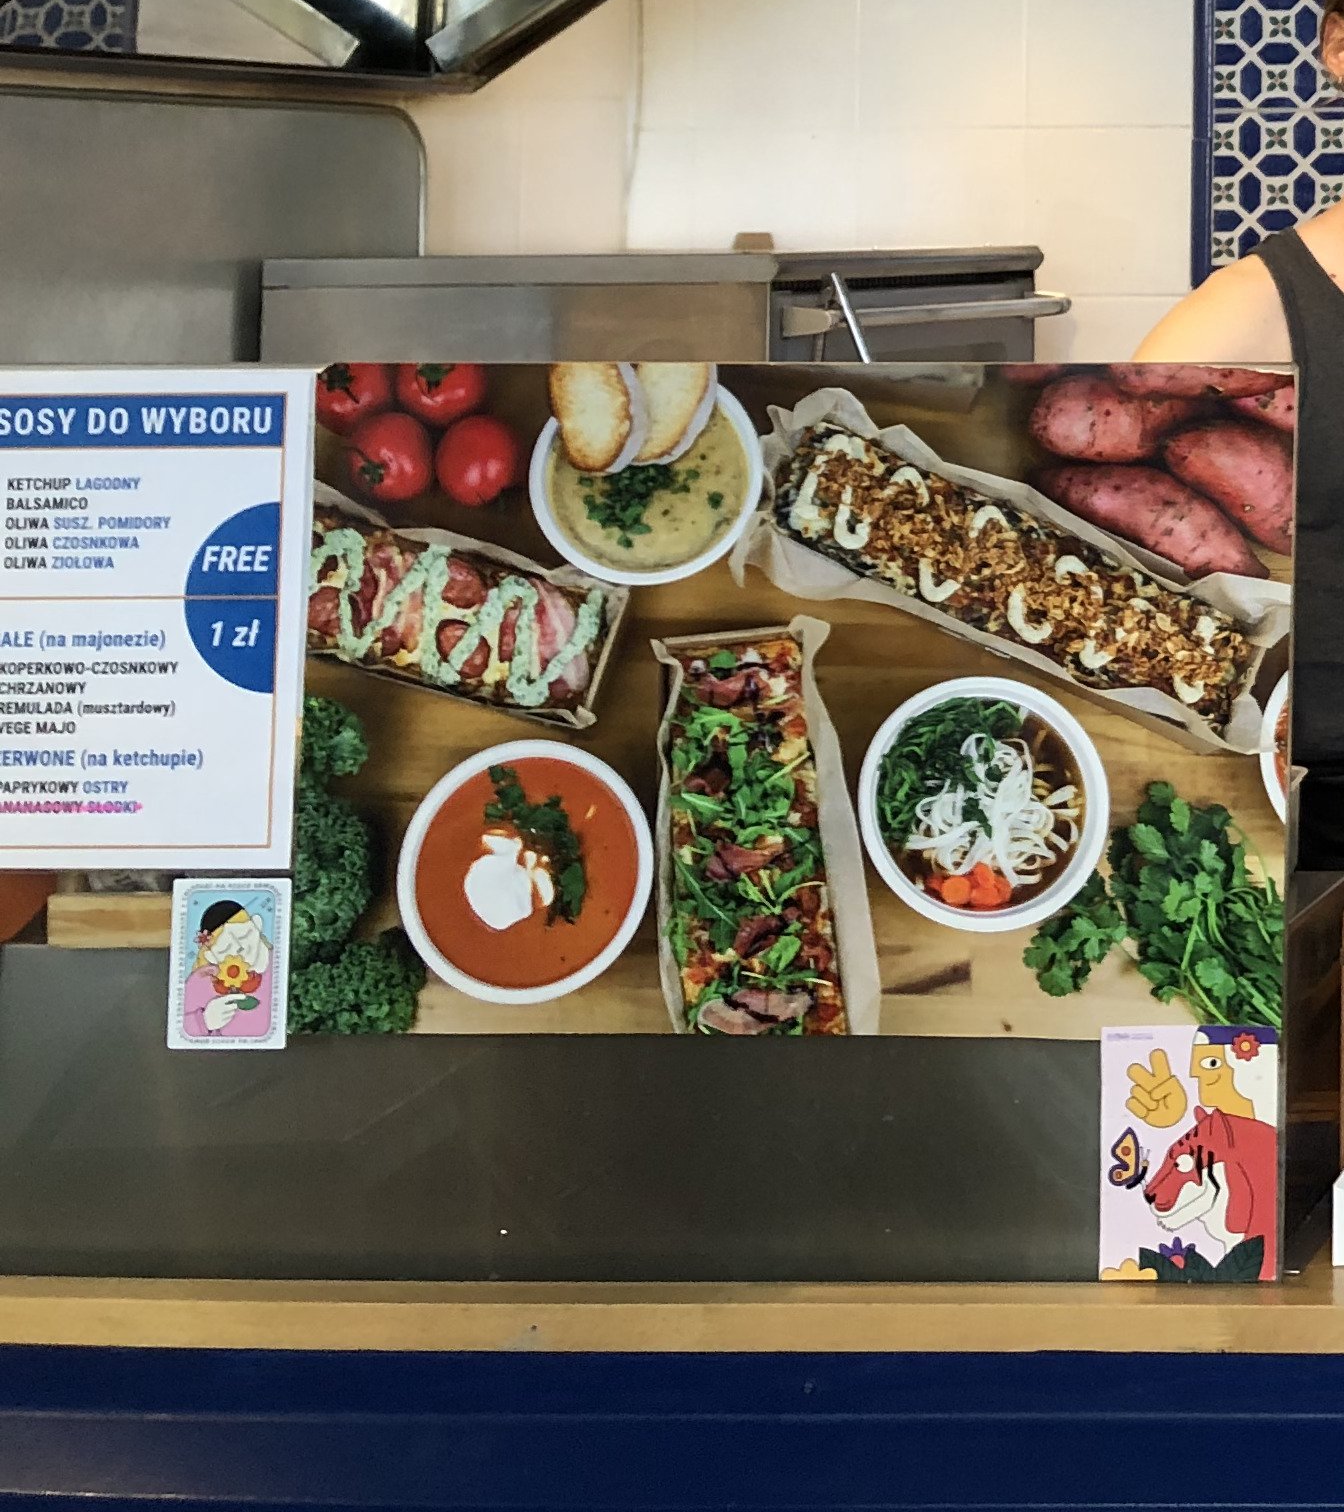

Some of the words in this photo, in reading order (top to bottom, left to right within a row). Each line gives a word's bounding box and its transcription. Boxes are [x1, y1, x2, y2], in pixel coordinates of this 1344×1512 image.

[0, 407, 77, 436] SOSY
[87, 407, 130, 436] DO
[141, 406, 273, 435] WYBORU
[7, 477, 72, 491] KETCHUP
[6, 497, 89, 511] BALSAMICO
[5, 517, 50, 530] OLIWA
[98, 516, 171, 530] POMIDORY
[4, 536, 49, 550] OLIWA
[3, 556, 47, 570] OLIWA
[201, 544, 273, 573] FREE
[39, 630, 67, 651] (na
[71, 630, 166, 651] majonezie)
[210, 620, 224, 648] 1
[231, 618, 261, 648] zł
[80, 748, 108, 770] (na
[112, 748, 205, 770] ketchupie)
